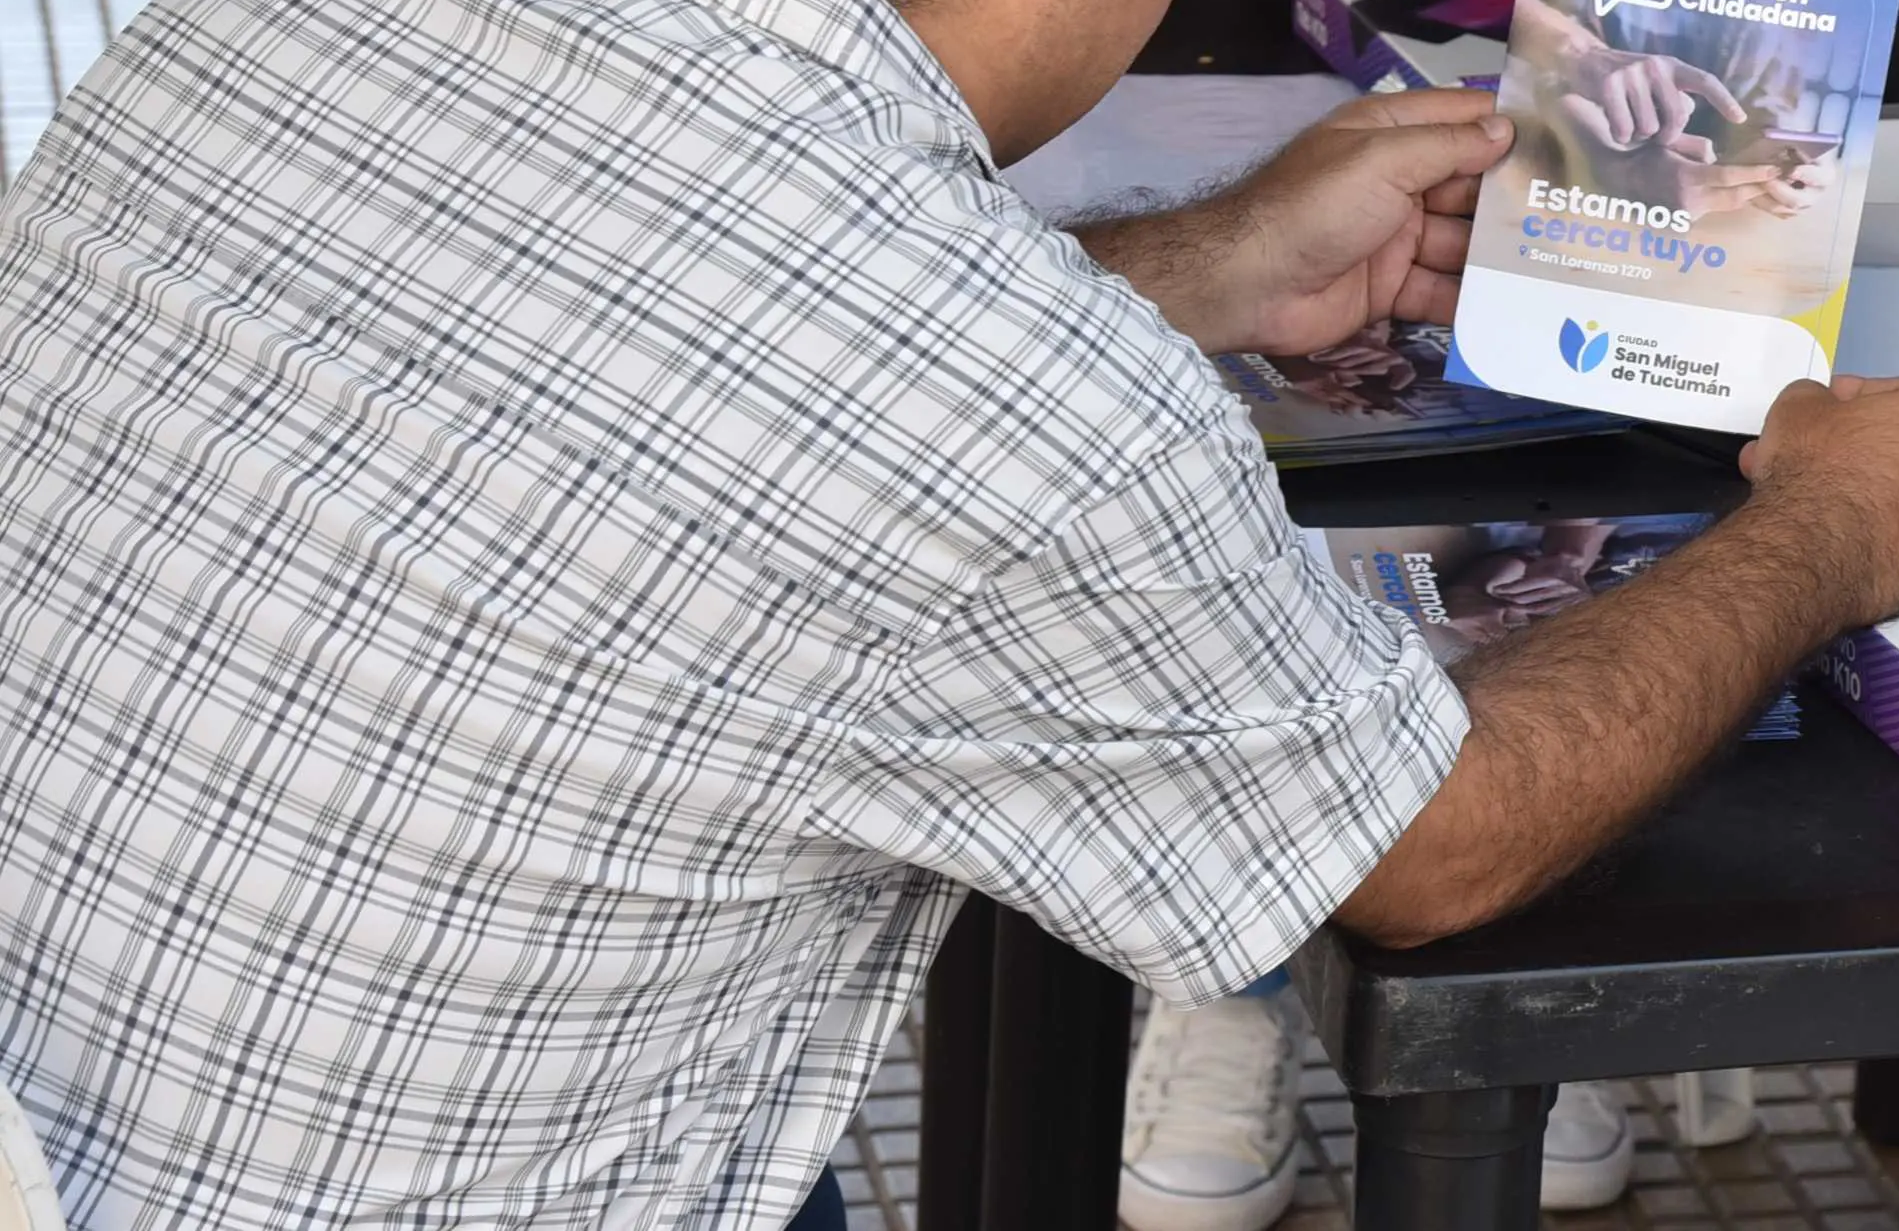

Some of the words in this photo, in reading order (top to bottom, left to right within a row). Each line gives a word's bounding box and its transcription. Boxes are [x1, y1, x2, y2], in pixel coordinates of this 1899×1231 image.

[1527, 178, 1692, 233] Estamos
[1522, 214, 1631, 253] cerca
[1639, 228, 1727, 273] tuyo
[1529, 248, 1559, 265] San
[1560, 253, 1619, 275] Lorenzo
[1621, 264, 1652, 280] 1270
[1617, 334, 1659, 348] CIUDAD
[1241, 352, 1294, 389] amos
[1614, 346, 1650, 366] San
[1653, 353, 1720, 377] Miguel
[1611, 365, 1636, 382] de
[1639, 369, 1731, 398] Tucumán
[1402, 553, 1451, 625] Estamos
